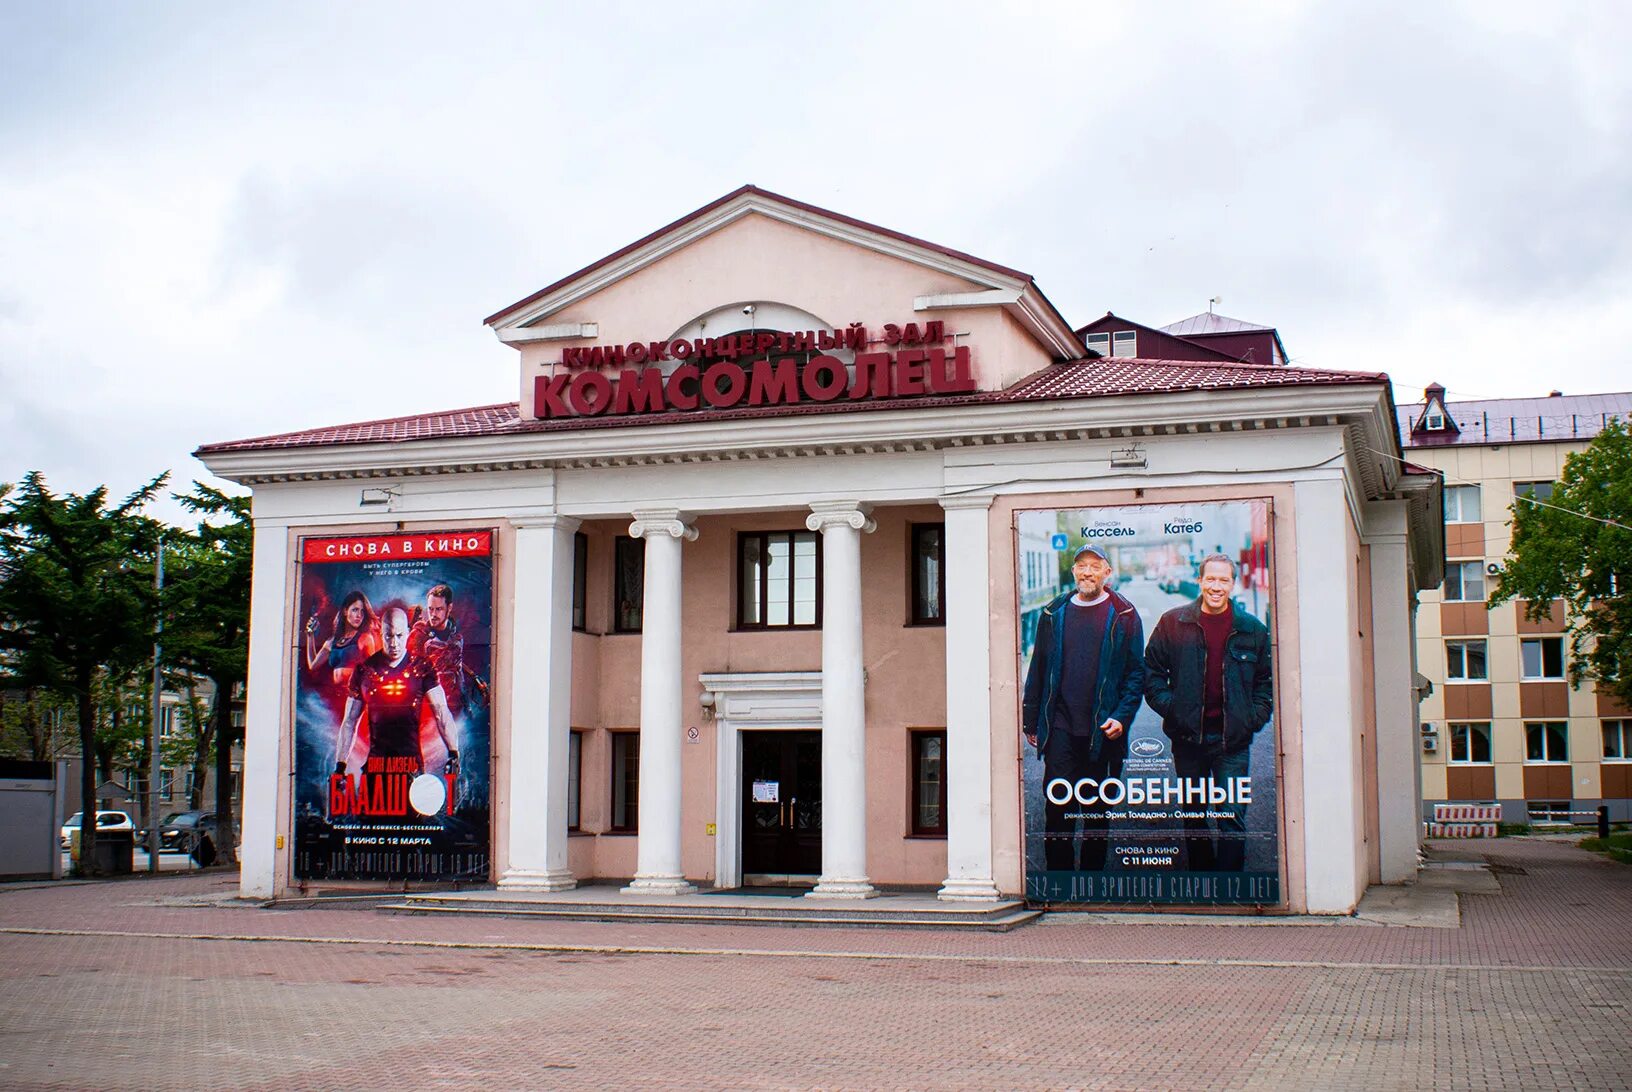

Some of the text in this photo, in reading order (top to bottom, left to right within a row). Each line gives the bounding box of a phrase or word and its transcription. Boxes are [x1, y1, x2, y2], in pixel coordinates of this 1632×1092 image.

[562, 320, 945, 368] КИНОКОНЦЕРТНЫЙ ЗАЛ
[533, 345, 977, 419] КОМСОМОЛЕЦ
[1080, 526, 1136, 538] Кассель
[1164, 522, 1203, 534] Катеб
[326, 538, 479, 556] СНОВА В КИНО
[331, 773, 457, 816] БЛАДШТ
[1046, 777, 1252, 806] ОСОБЕННЫЕ
[1105, 810, 1126, 819] Эрик
[1128, 810, 1167, 819] Толедано
[1174, 810, 1205, 818] Оливье
[1206, 810, 1235, 818] Накаш
[1154, 846, 1180, 854] КИНО
[1122, 857, 1130, 865] С
[1142, 857, 1172, 865] ИЮНЯ
[1071, 876, 1094, 900] ДЛЯ
[1102, 874, 1162, 898] ЗРИТЕЛЕЙ
[1171, 876, 1218, 898] СТАРШЕ
[1228, 878, 1240, 898] 12
[1250, 877, 1272, 898] ЛЕТ
